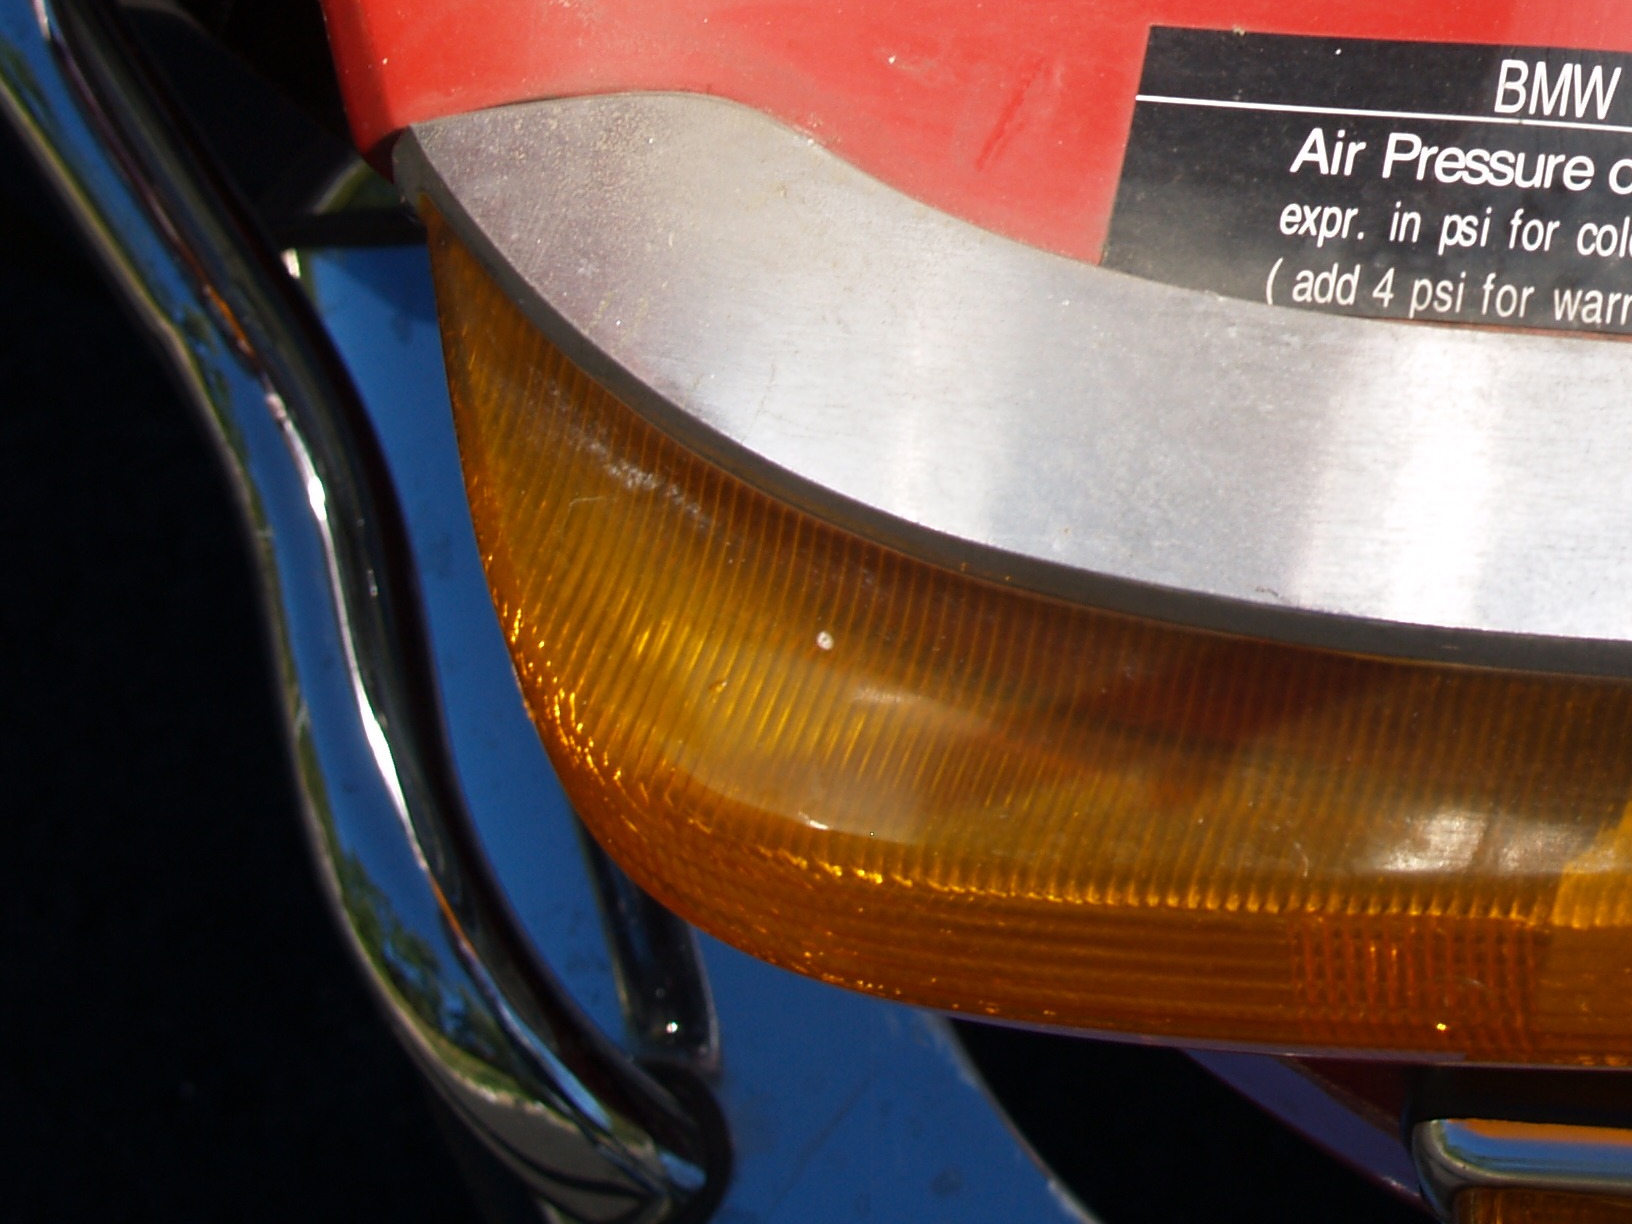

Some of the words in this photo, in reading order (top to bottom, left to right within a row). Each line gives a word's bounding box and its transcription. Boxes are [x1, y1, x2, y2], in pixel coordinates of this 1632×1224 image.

[1493, 58, 1623, 121] BMW
[1289, 127, 1367, 177] Air
[1381, 131, 1596, 192] Pressure
[1279, 202, 1365, 249] expr.
[1388, 202, 1422, 244] in
[1437, 208, 1491, 257] psi
[1508, 207, 1561, 252] for
[1371, 266, 1395, 310] 4
[1407, 271, 1467, 320] psi
[1480, 271, 1536, 319] for
